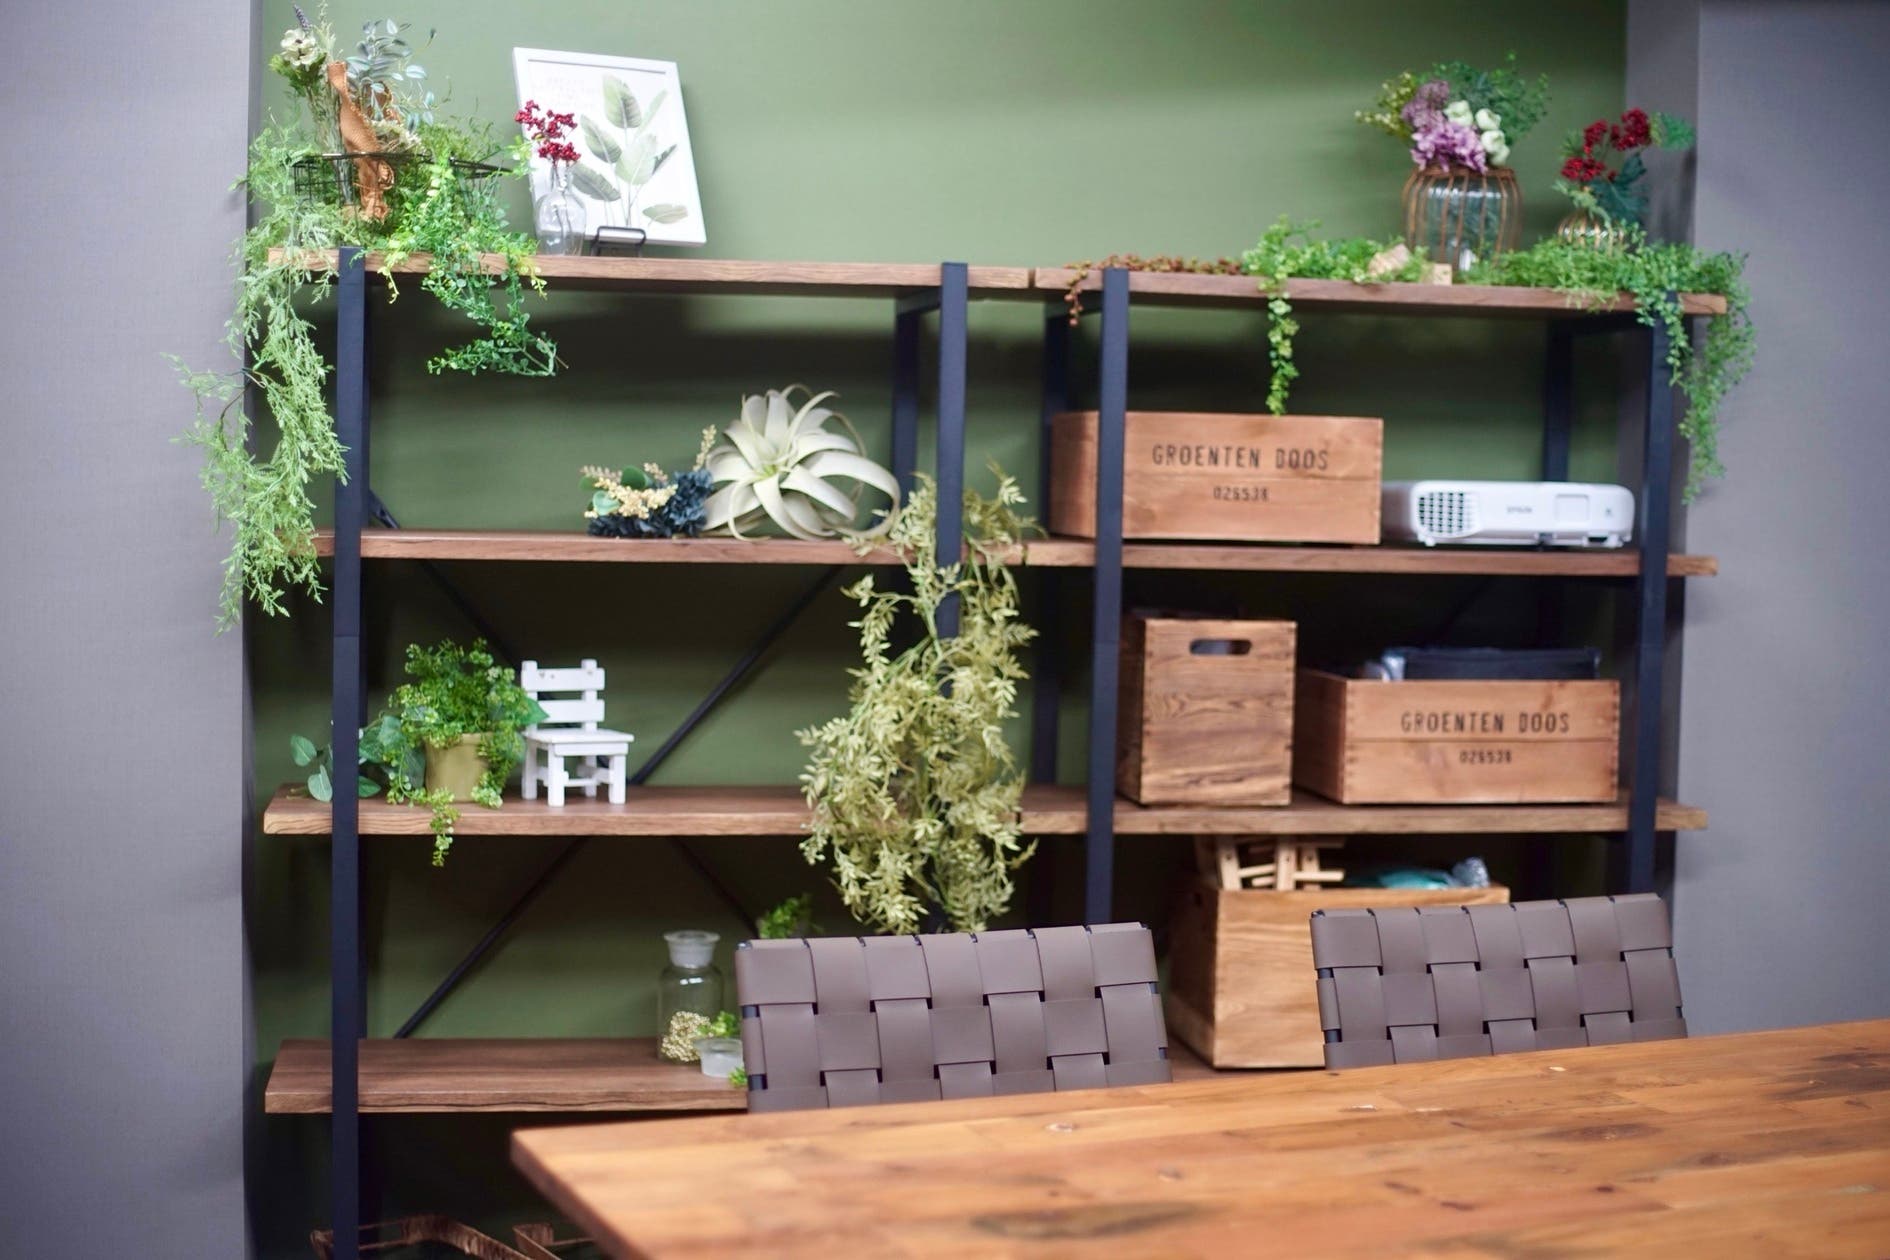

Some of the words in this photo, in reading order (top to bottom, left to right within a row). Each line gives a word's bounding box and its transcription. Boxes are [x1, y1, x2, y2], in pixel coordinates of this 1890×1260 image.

[1152, 444, 1261, 468] GROENTEN
[1275, 448, 1329, 470] DOOS
[1401, 711, 1504, 733] GROENTEN
[1519, 712, 1570, 733] DOOS
